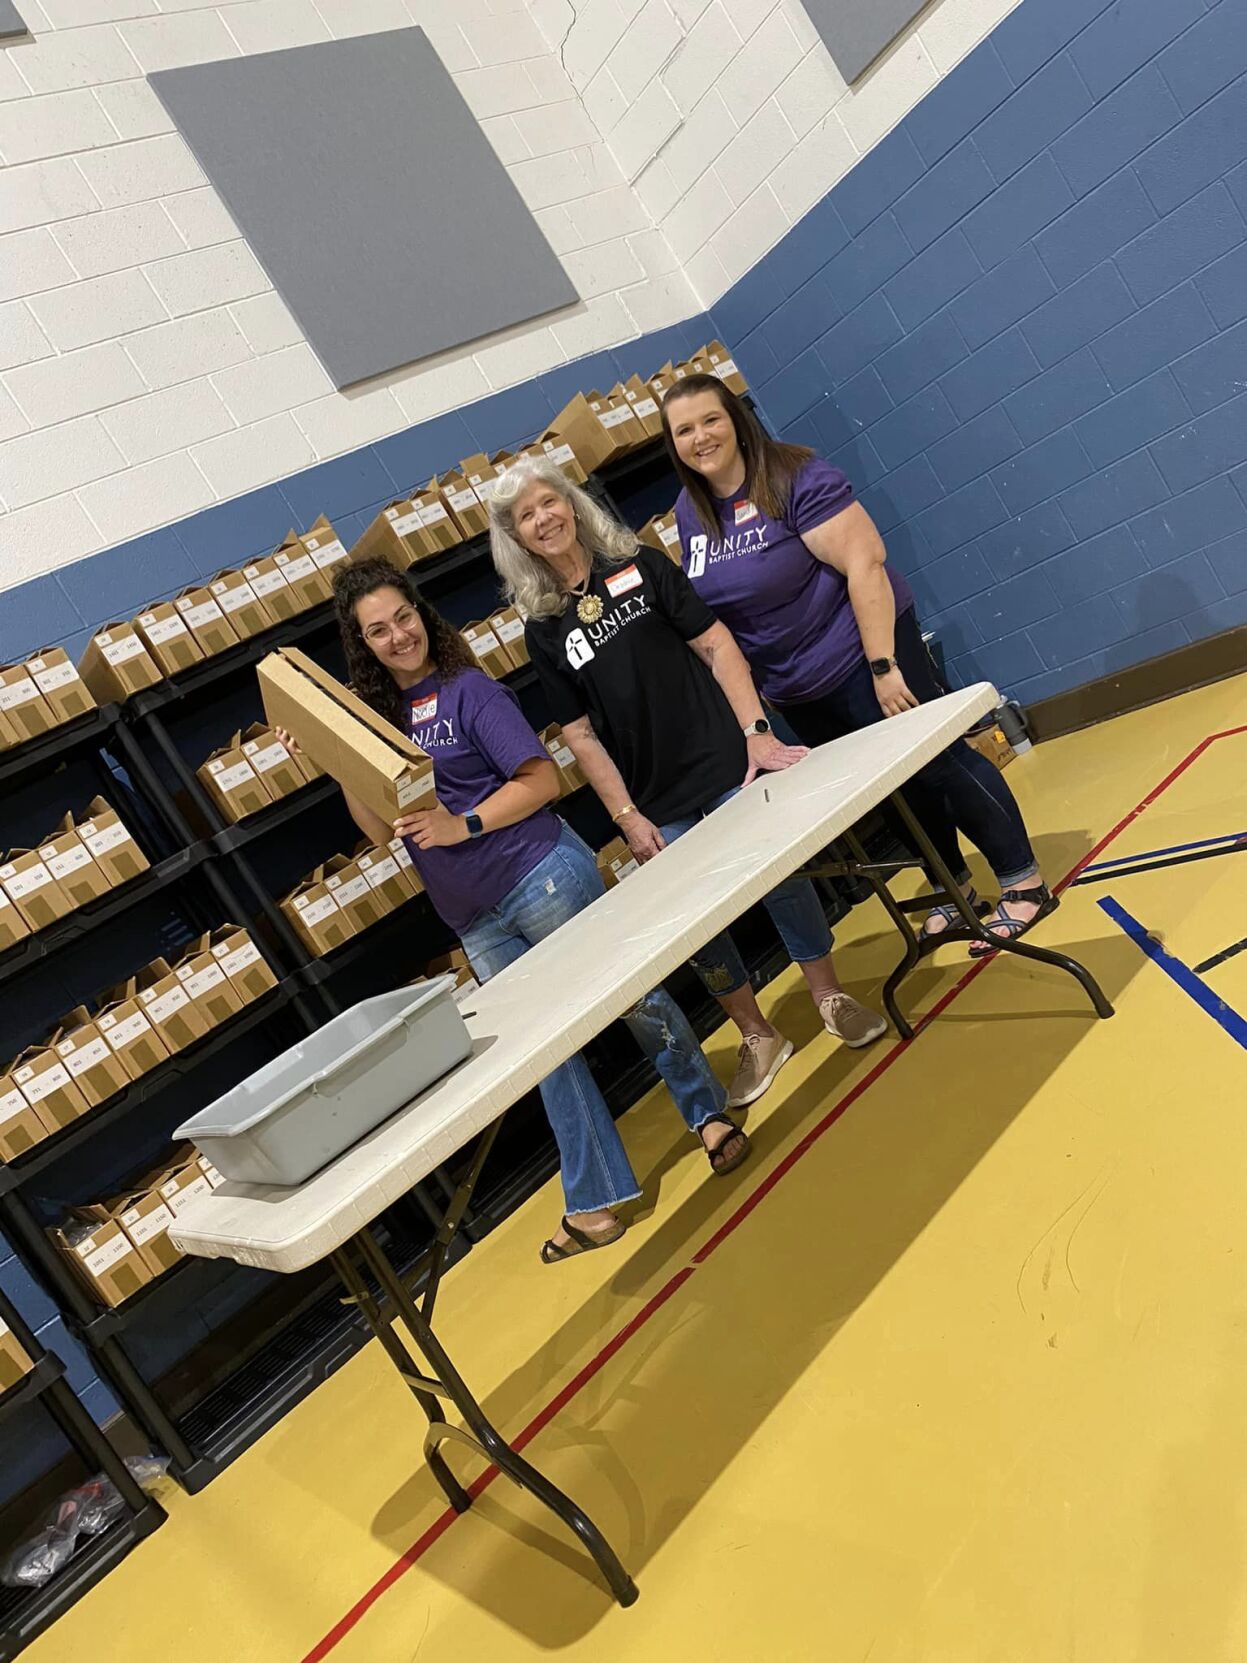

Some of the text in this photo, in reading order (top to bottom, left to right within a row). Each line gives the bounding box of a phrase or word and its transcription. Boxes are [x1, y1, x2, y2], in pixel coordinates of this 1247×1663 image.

[709, 542, 768, 564] BAPTIST CHURCH
[710, 524, 767, 556] UNITY
[589, 595, 645, 640] UNITY
[594, 606, 651, 647] BAPTIST CHURCH
[410, 718, 453, 745] NITY
